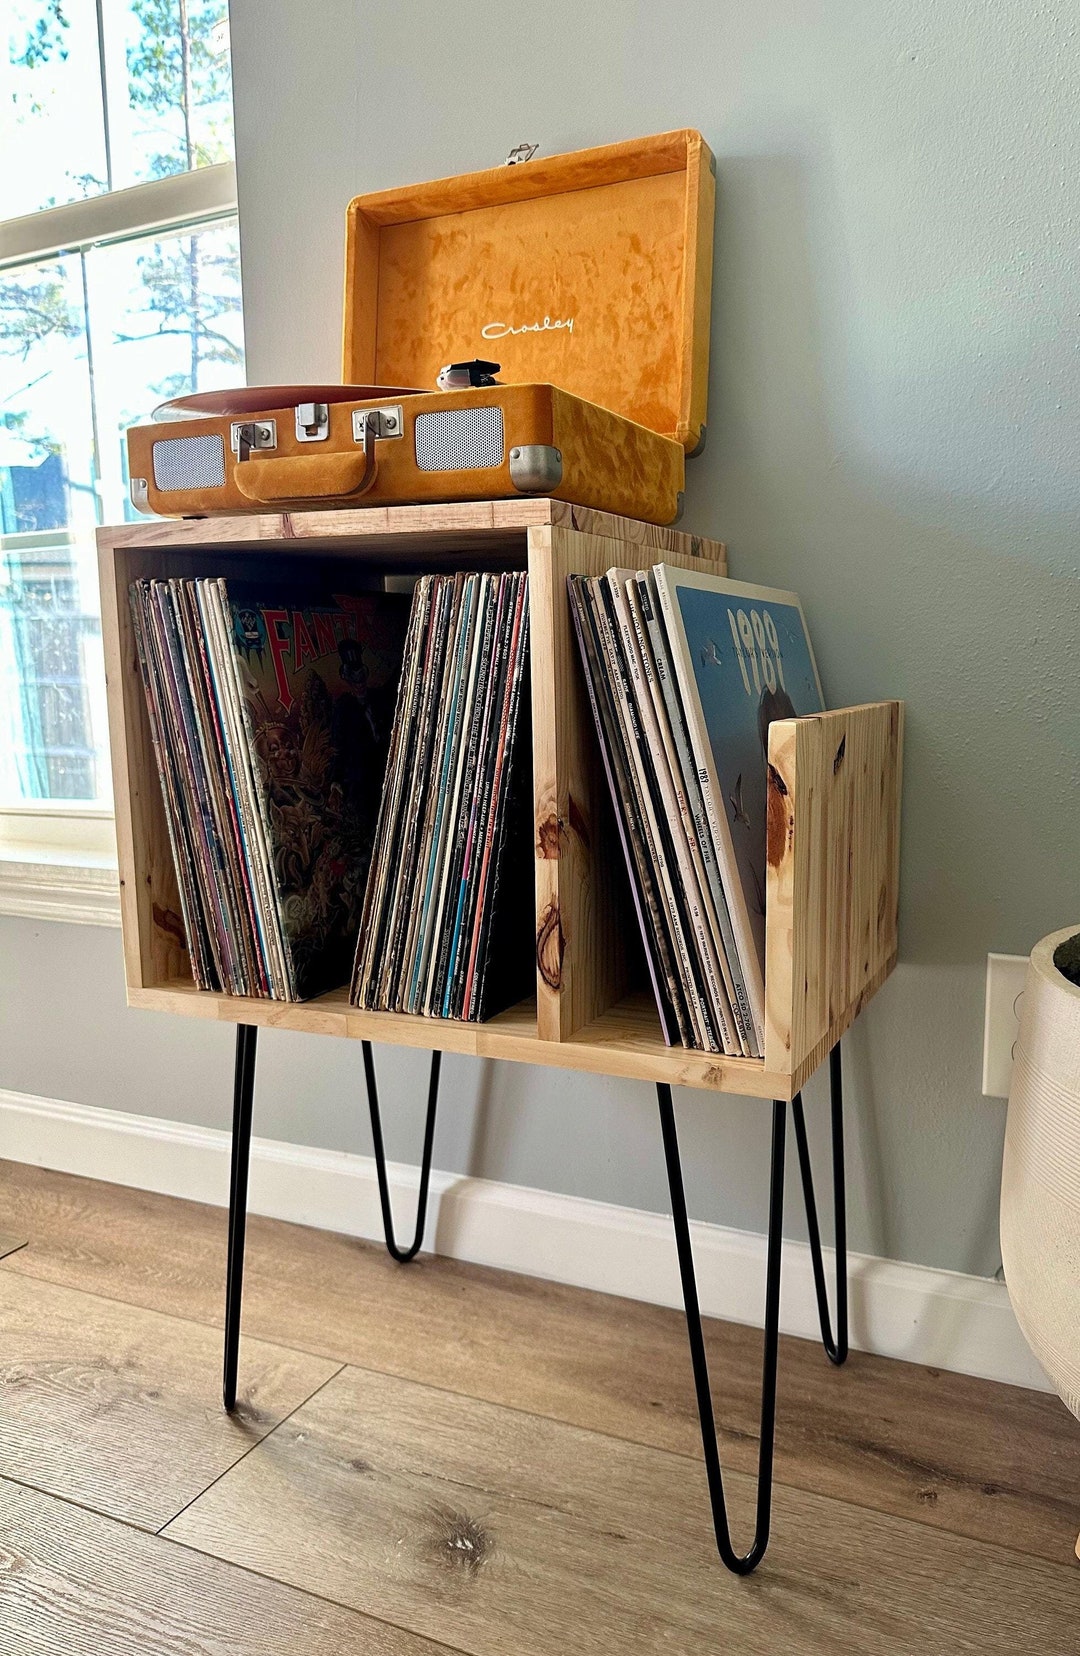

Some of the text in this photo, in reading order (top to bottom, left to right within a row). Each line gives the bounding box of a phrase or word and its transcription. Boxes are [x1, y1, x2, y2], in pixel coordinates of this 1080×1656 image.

[481, 315, 574, 339] Crosley
[622, 624, 633, 654] FLEETWOOD
[632, 667, 640, 680] TUSK
[632, 615, 646, 650] ROLLING
[641, 652, 654, 683] STONES
[656, 657, 666, 681] CREAM
[727, 608, 786, 696] 1989
[409, 684, 420, 717] CONVENTION
[621, 677, 629, 693] SADE
[697, 767, 709, 784] 1989
[710, 820, 722, 851] VERSION
[694, 813, 711, 863] WHEELS OF FIRE
[471, 971, 479, 996] COLUMBIA
[701, 940, 710, 960] WARNER
[709, 974, 719, 998] RECORDS
[698, 997, 709, 1024] PORTRAIT
[731, 1002, 741, 1020] COC
[734, 982, 752, 1031] ATCO SD 2-700
